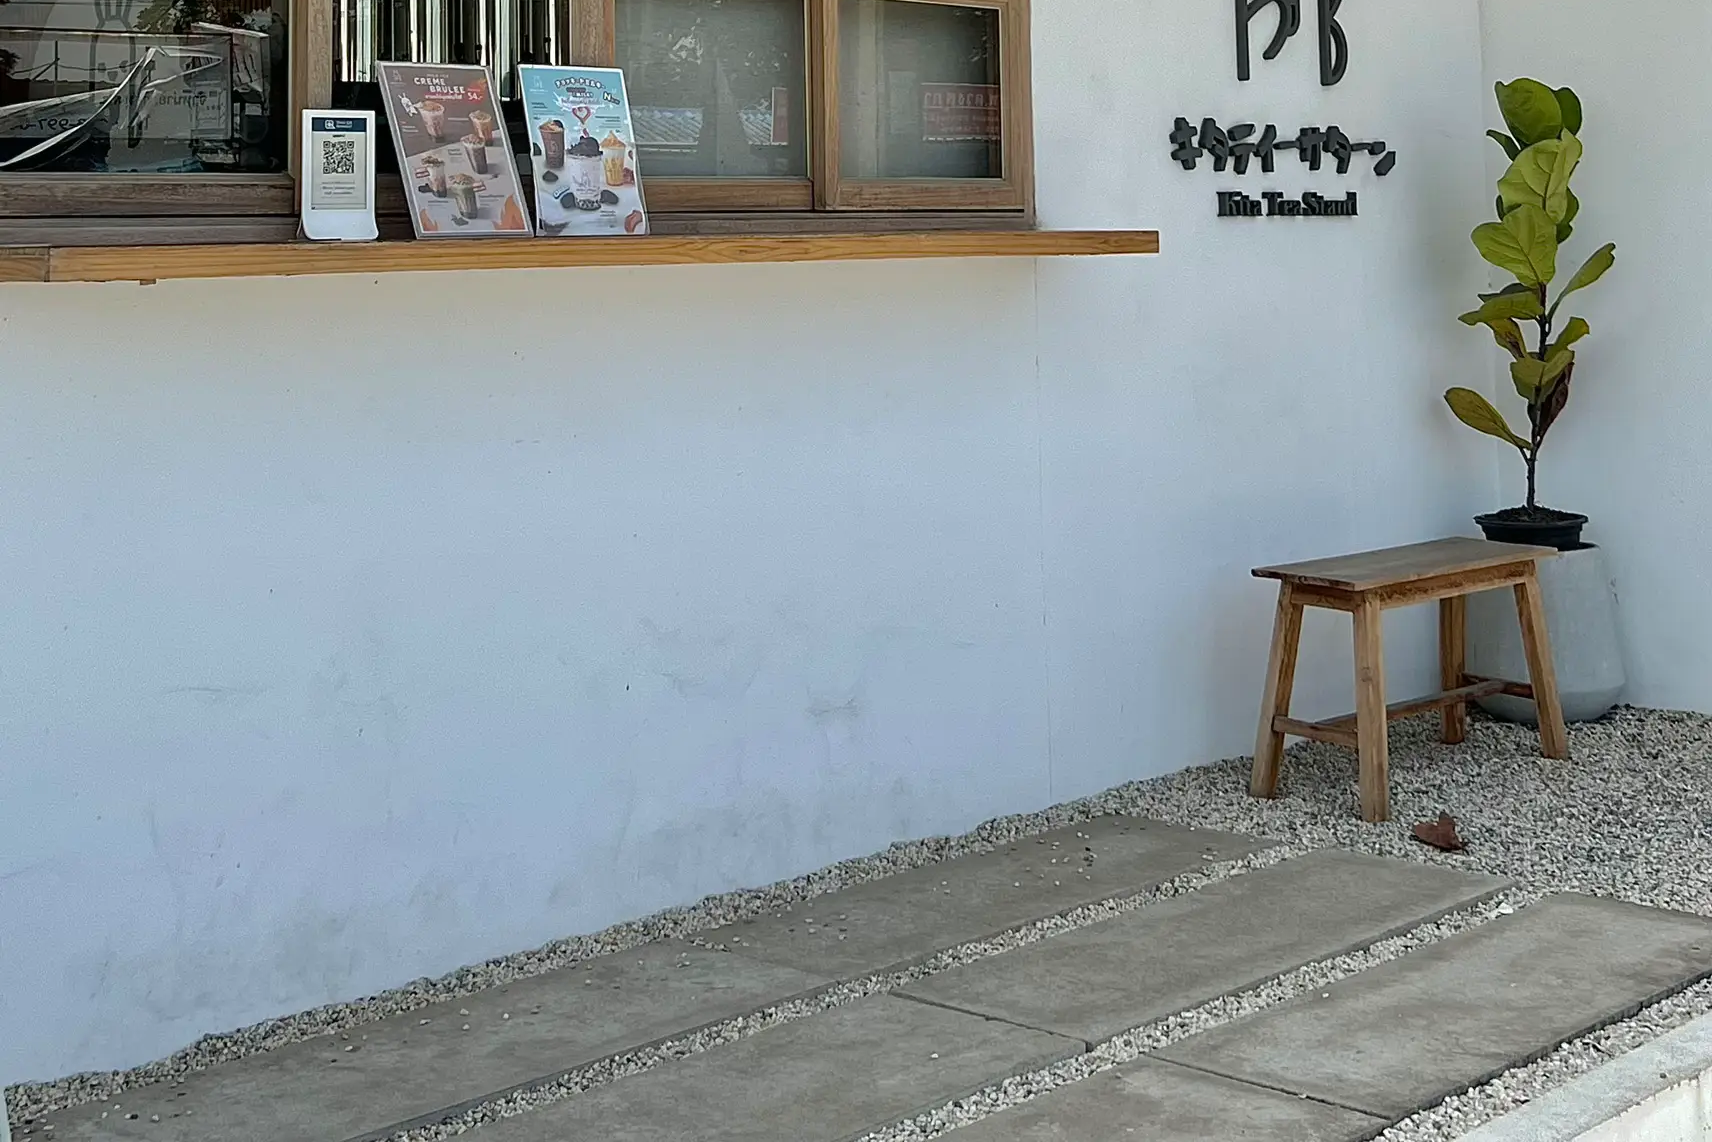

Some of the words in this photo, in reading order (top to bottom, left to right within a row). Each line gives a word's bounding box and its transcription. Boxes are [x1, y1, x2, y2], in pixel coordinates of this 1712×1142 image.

[413, 76, 446, 86] CREME
[429, 85, 465, 94] BRULEE
[1216, 191, 1263, 217] Kita
[1262, 191, 1303, 217] Tea
[1302, 191, 1358, 217] Stand
